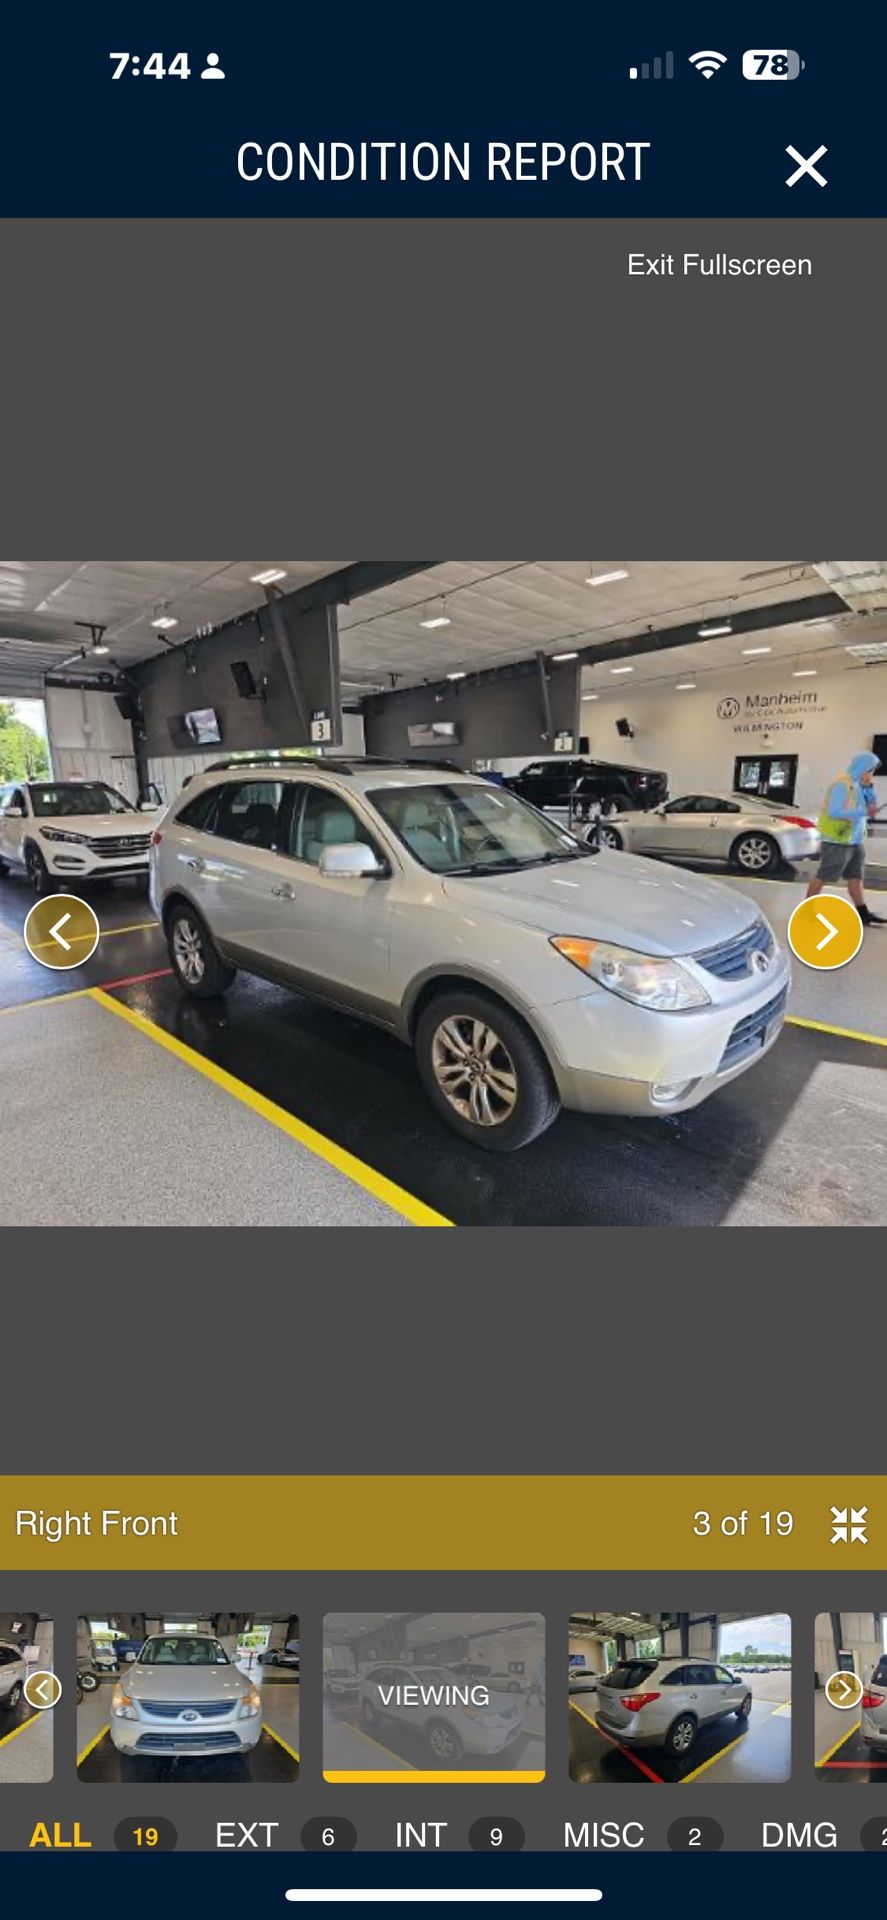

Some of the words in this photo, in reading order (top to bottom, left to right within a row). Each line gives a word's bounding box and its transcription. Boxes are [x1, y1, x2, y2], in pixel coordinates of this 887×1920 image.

[746, 691, 817, 707] Manheim
[318, 722, 324, 739] 3
[733, 721, 803, 733] WILMINGTON
